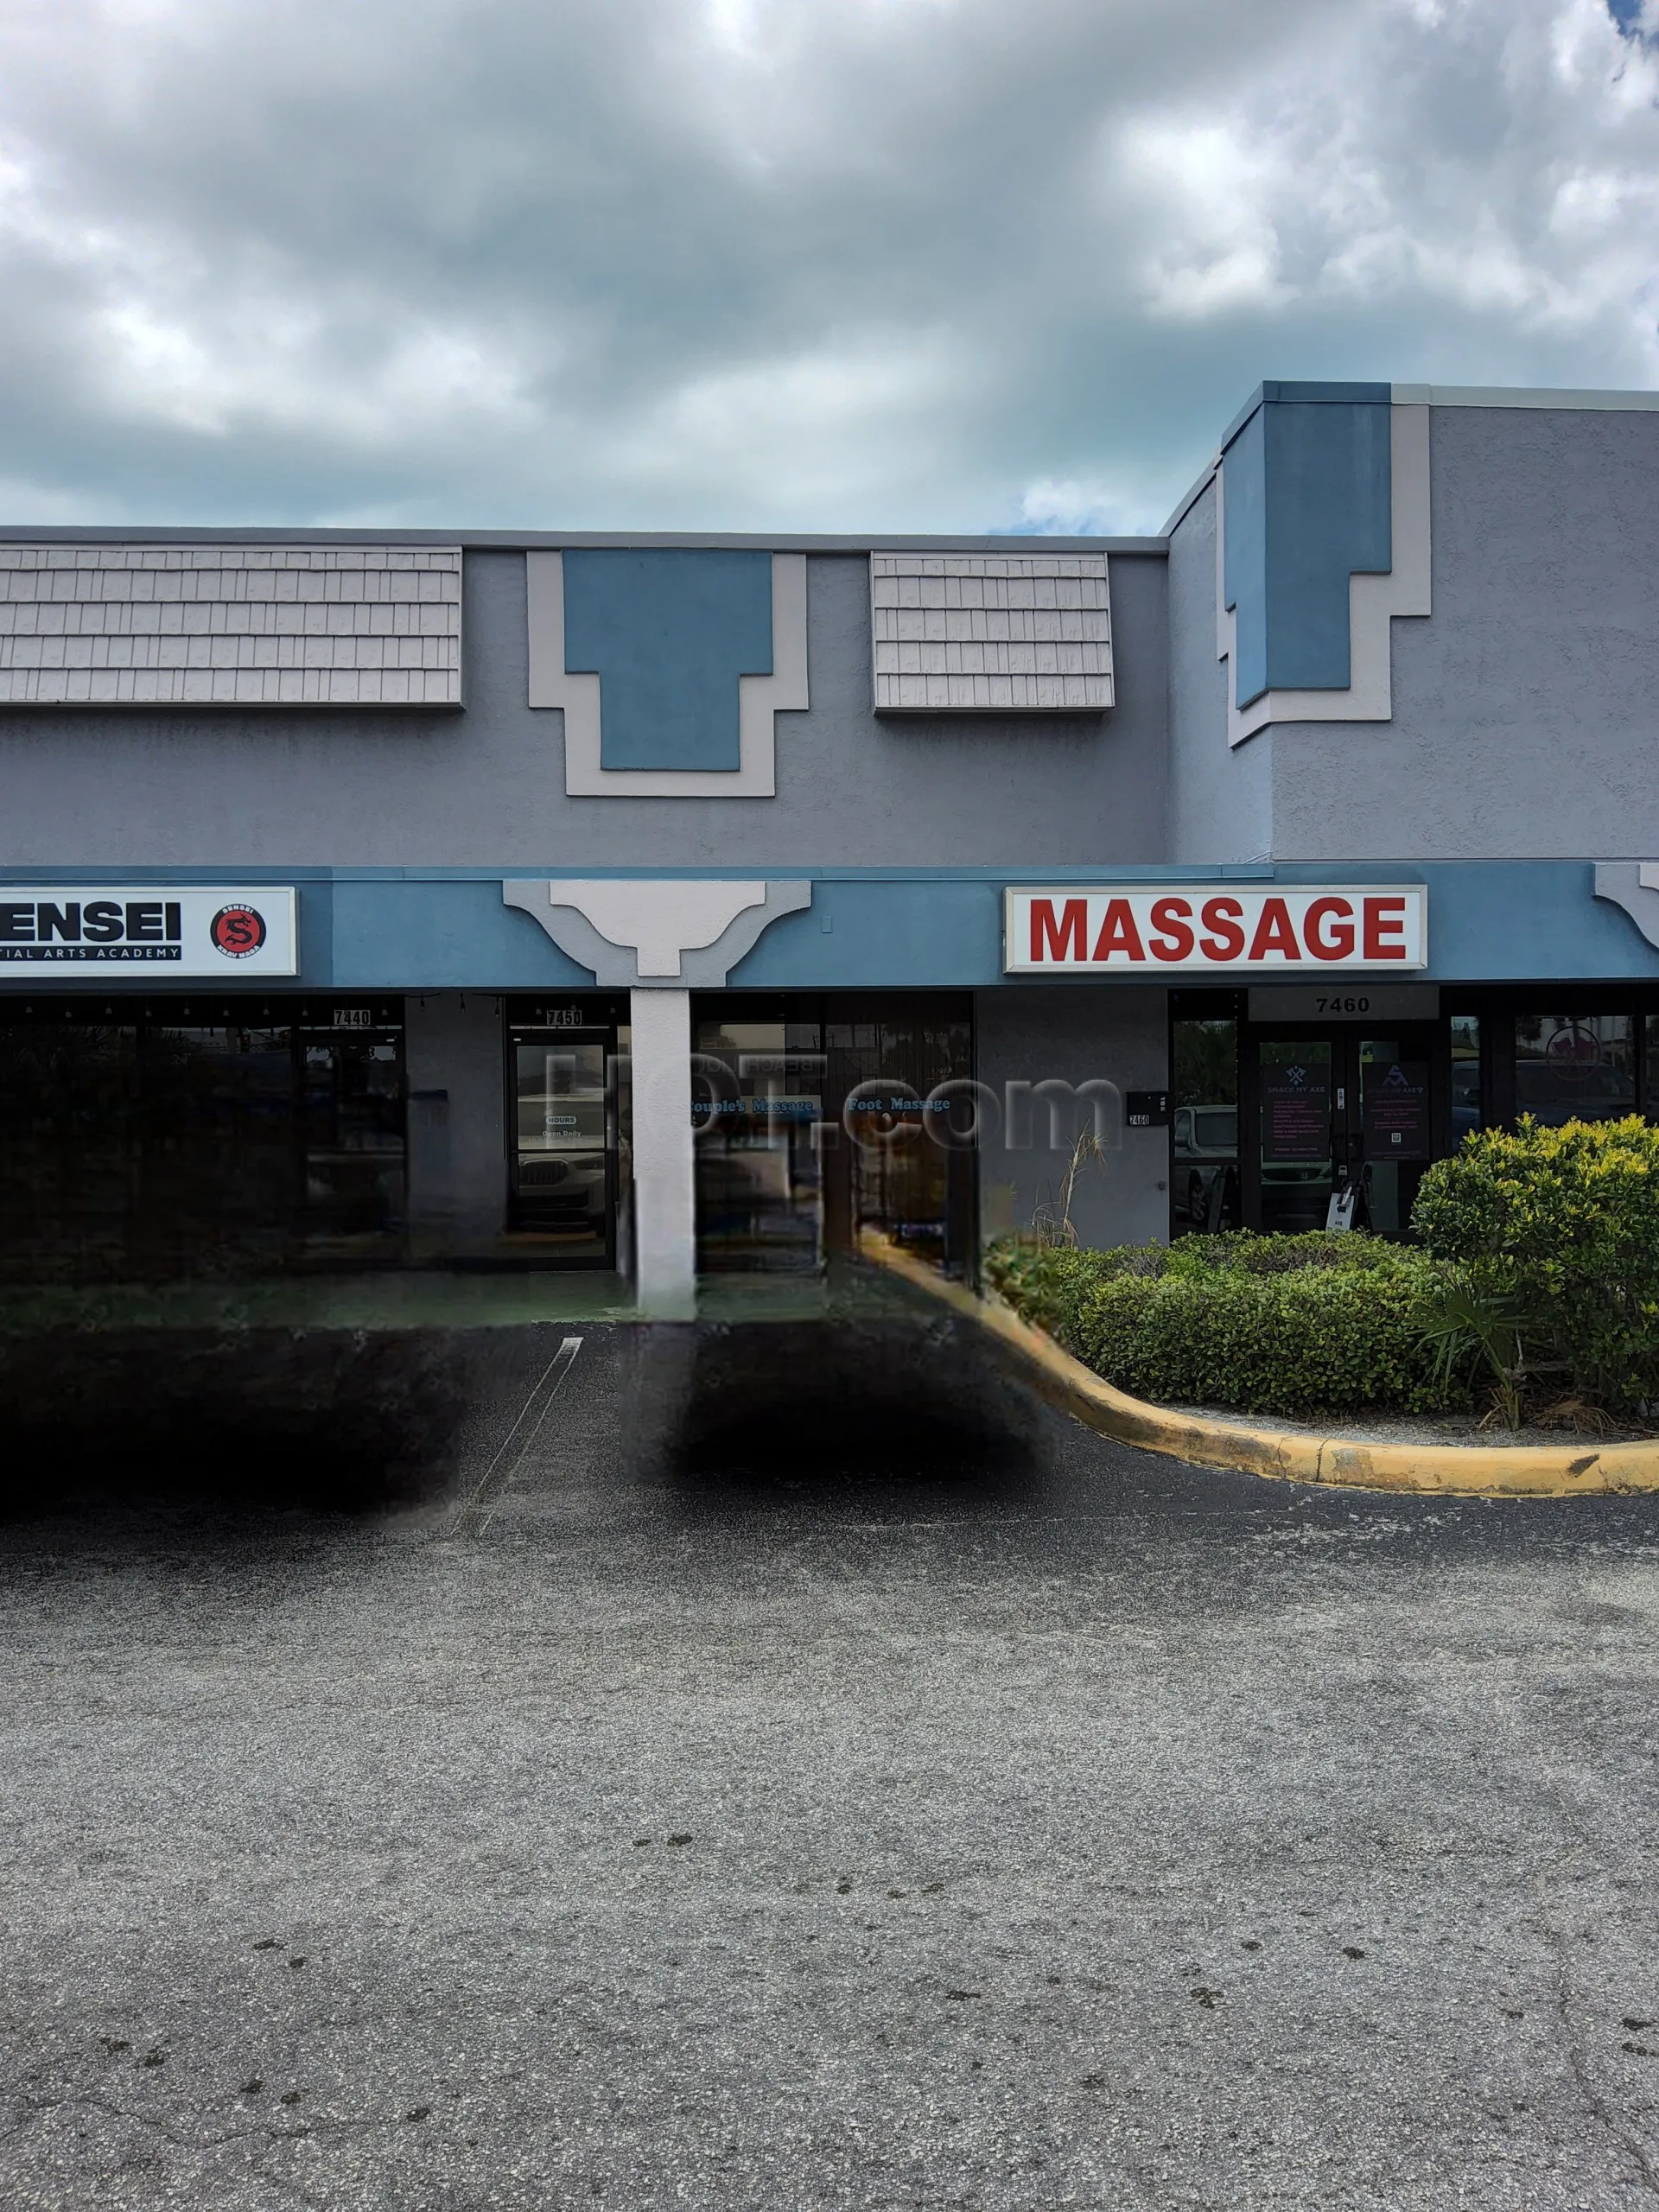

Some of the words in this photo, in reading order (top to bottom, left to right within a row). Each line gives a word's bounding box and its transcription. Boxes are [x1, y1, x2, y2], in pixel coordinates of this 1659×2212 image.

[222, 905, 254, 914] SENSEI
[0, 901, 181, 942] ENSEI
[1030, 897, 1406, 961] MASSAGE
[44, 949, 86, 958] ARTS
[97, 949, 180, 958] ACADEMY
[217, 944, 238, 957] KRAV
[1316, 997, 1370, 1013] 7460
[334, 1010, 370, 1025] 7440
[548, 1010, 582, 1025] 7450
[753, 1099, 814, 1114] Massage
[848, 1096, 883, 1110] Foot
[890, 1096, 950, 1113] Massage
[1129, 1116, 1148, 1125] 7460
